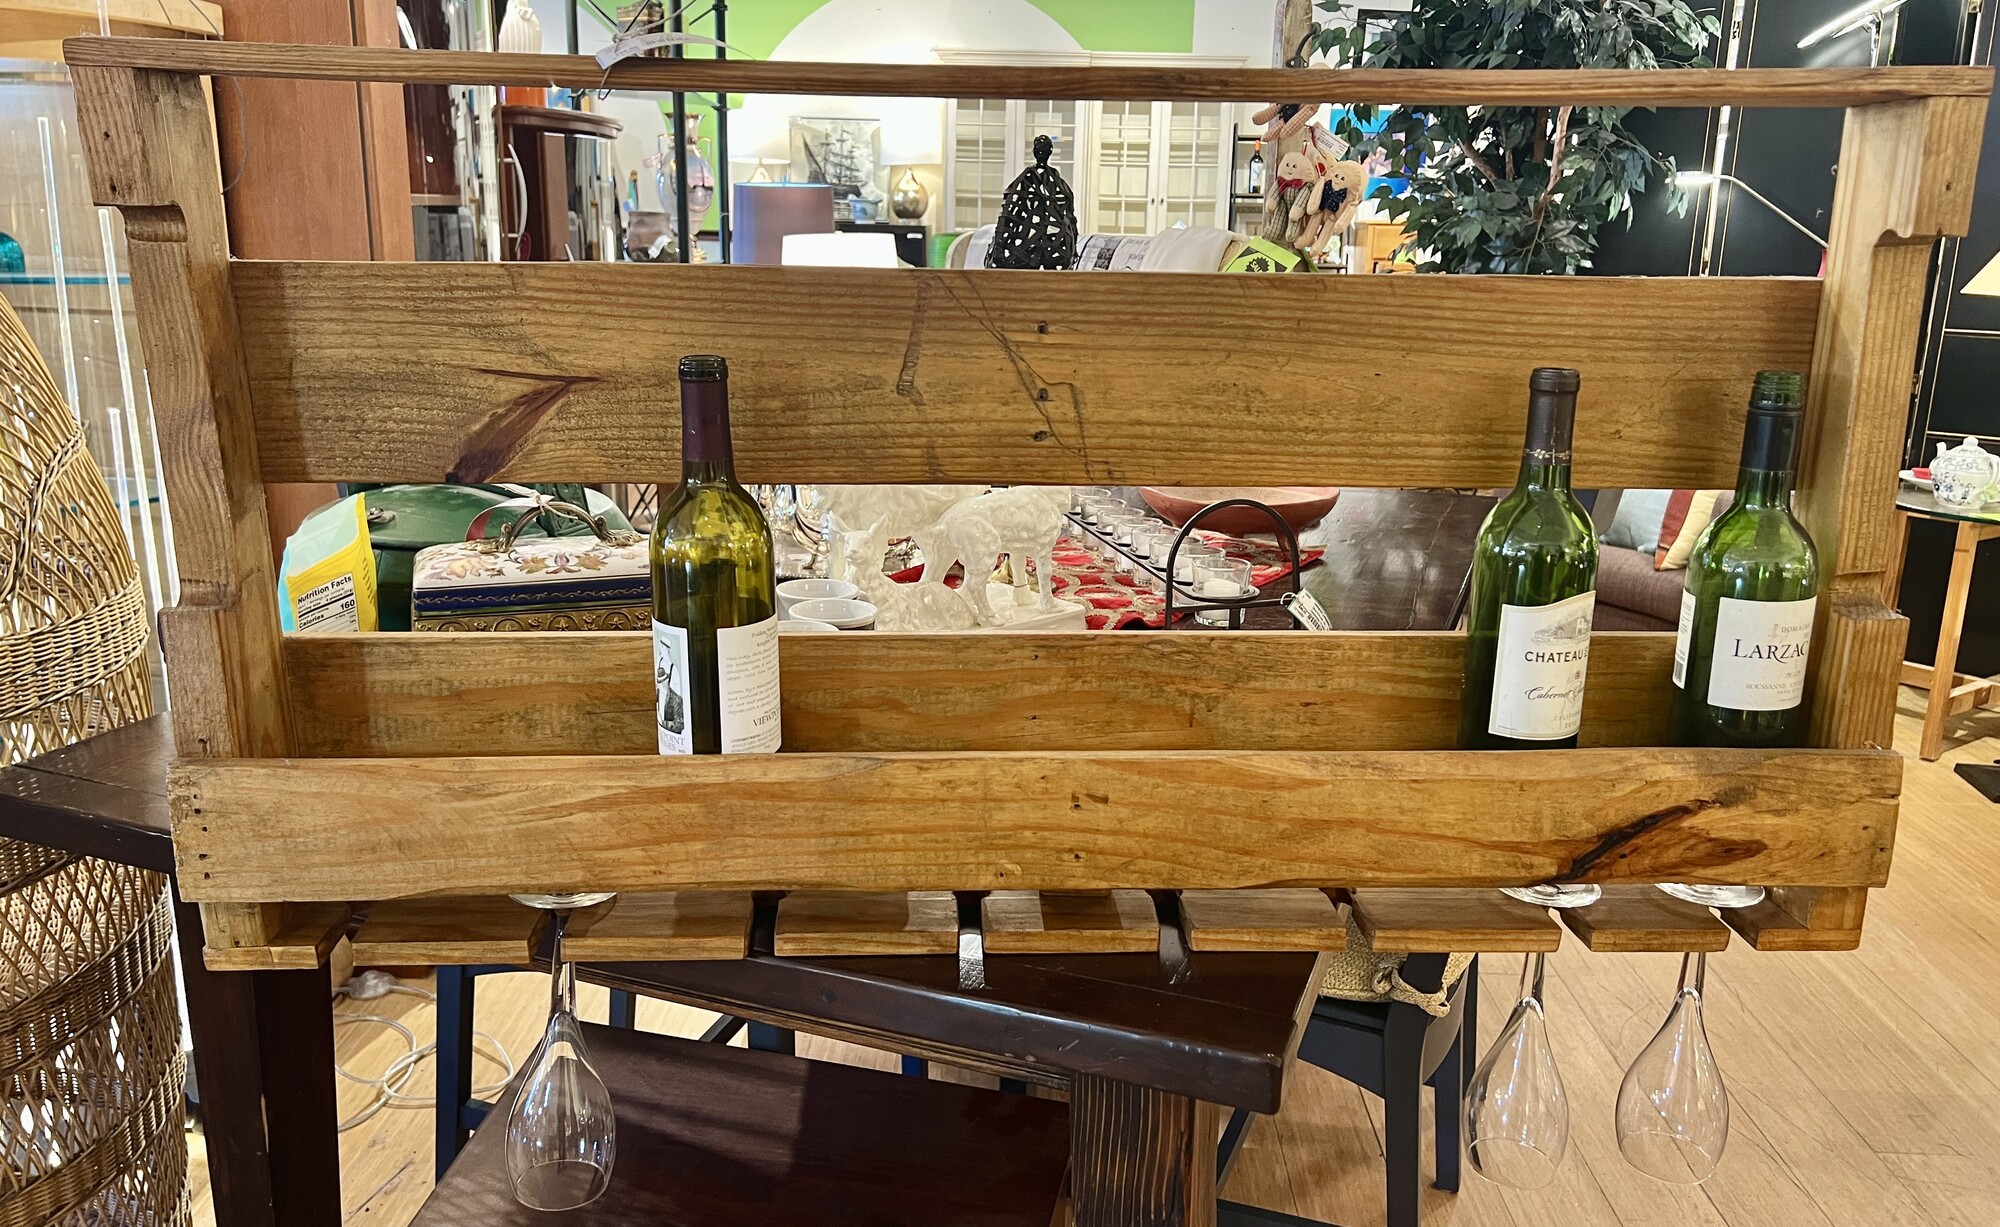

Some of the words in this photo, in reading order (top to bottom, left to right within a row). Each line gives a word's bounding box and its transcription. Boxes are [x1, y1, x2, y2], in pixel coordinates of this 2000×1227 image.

[298, 585, 330, 605] Nutrition
[331, 575, 352, 589] Facts
[299, 614, 325, 629] Calories
[340, 598, 356, 611] 160
[1525, 648, 1584, 663] CHATEAU
[1733, 638, 1809, 664] LARZAC
[1524, 685, 1573, 701] Cabernet
